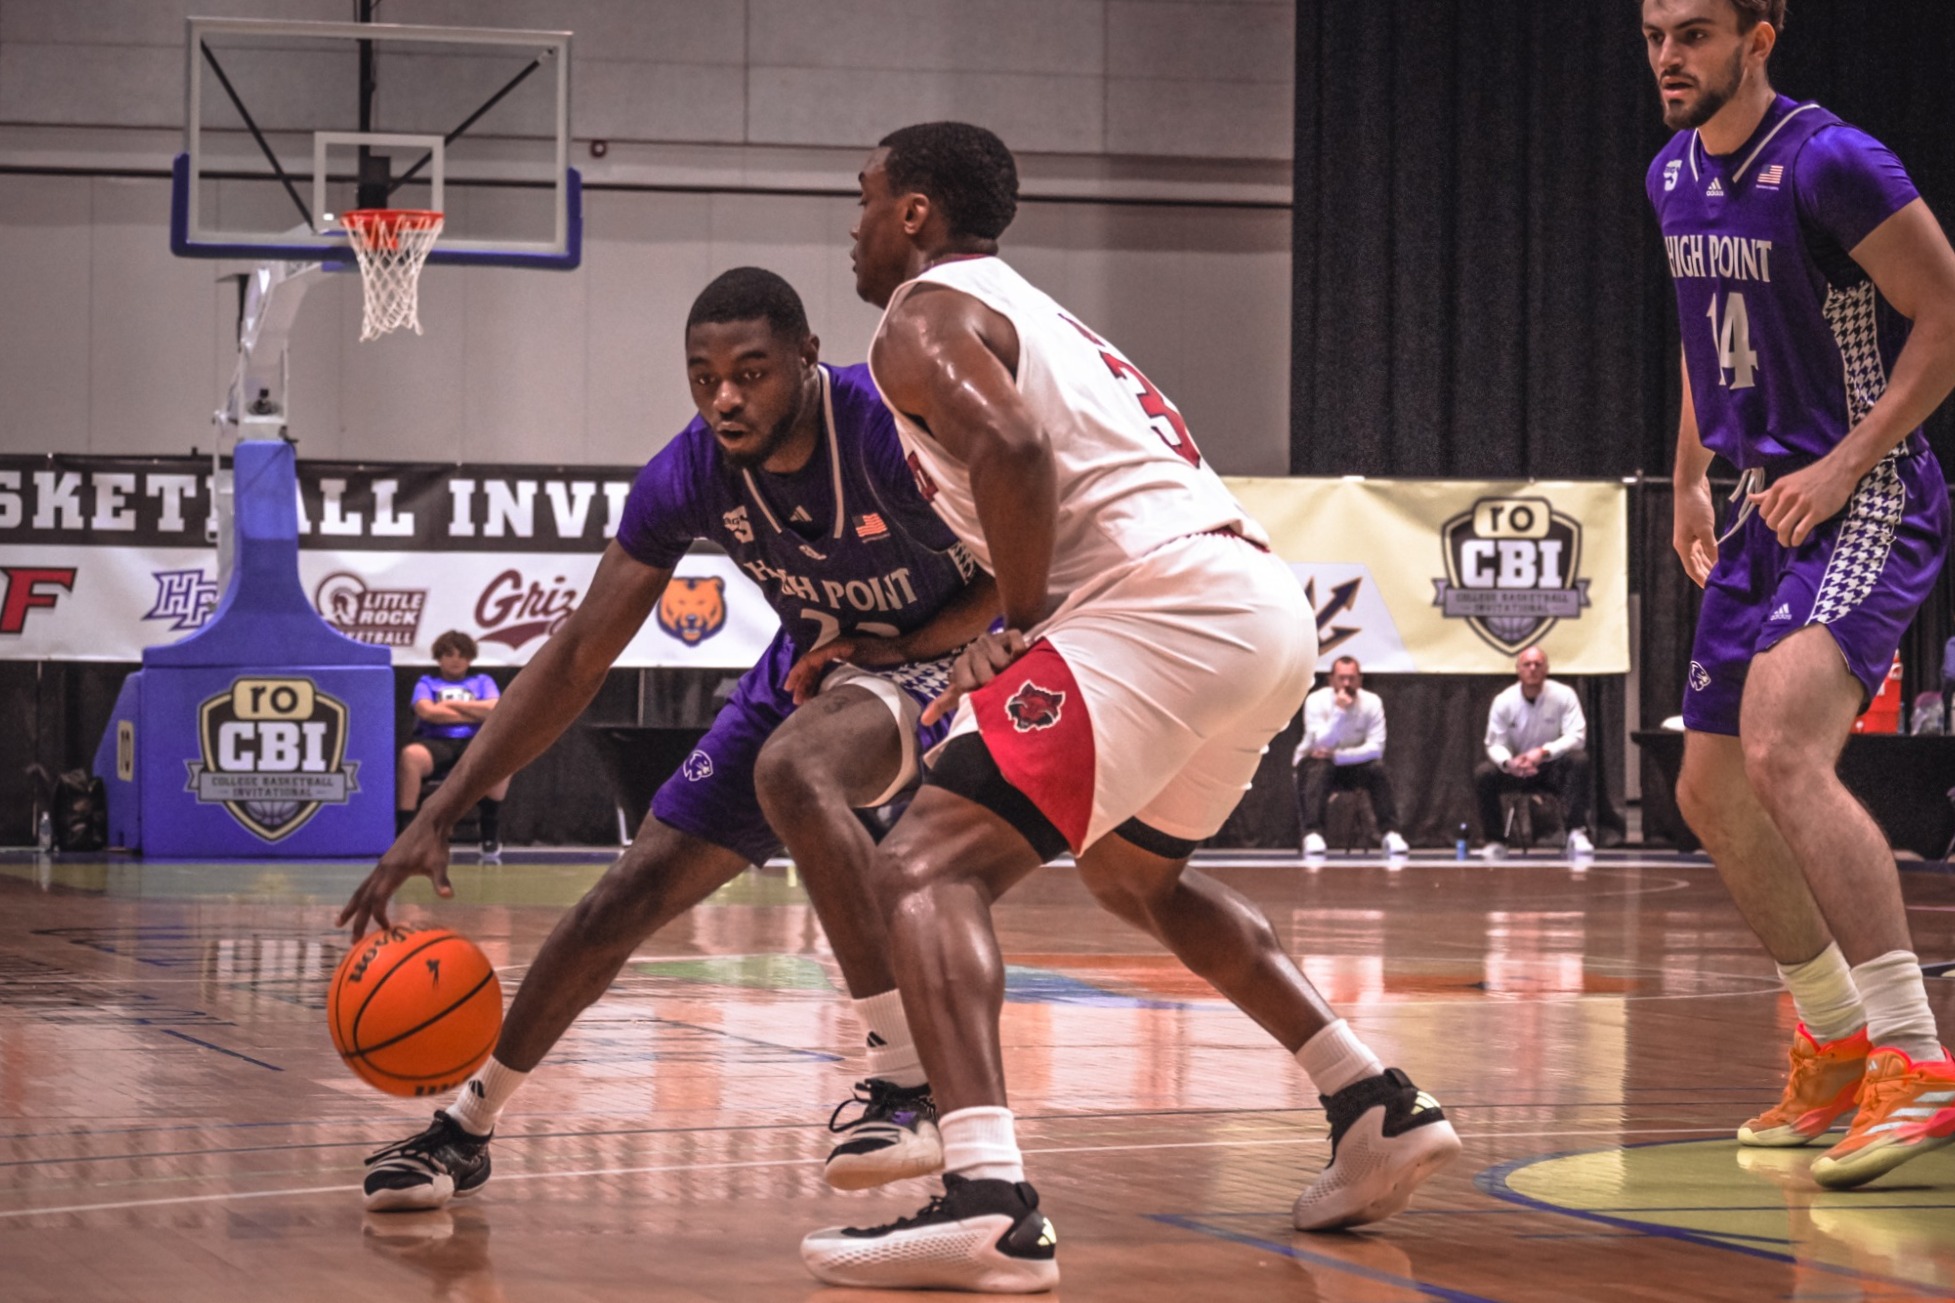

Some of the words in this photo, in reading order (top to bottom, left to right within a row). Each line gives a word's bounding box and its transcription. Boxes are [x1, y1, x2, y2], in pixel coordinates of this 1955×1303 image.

[1708, 235, 1772, 283] POINT
[1706, 292, 1759, 390] 14
[1489, 505, 1535, 532] ro
[1461, 540, 1563, 589] CBI
[0, 566, 78, 634] F
[363, 593, 423, 609] LITTLE
[474, 568, 577, 636] Griz
[821, 568, 918, 611] POINT
[358, 610, 419, 625] ROCK
[250, 685, 298, 714] ro
[218, 721, 327, 772] CBI
[233, 787, 312, 797] INVITATIONAL
[262, 776, 334, 787] BASKETBALL
